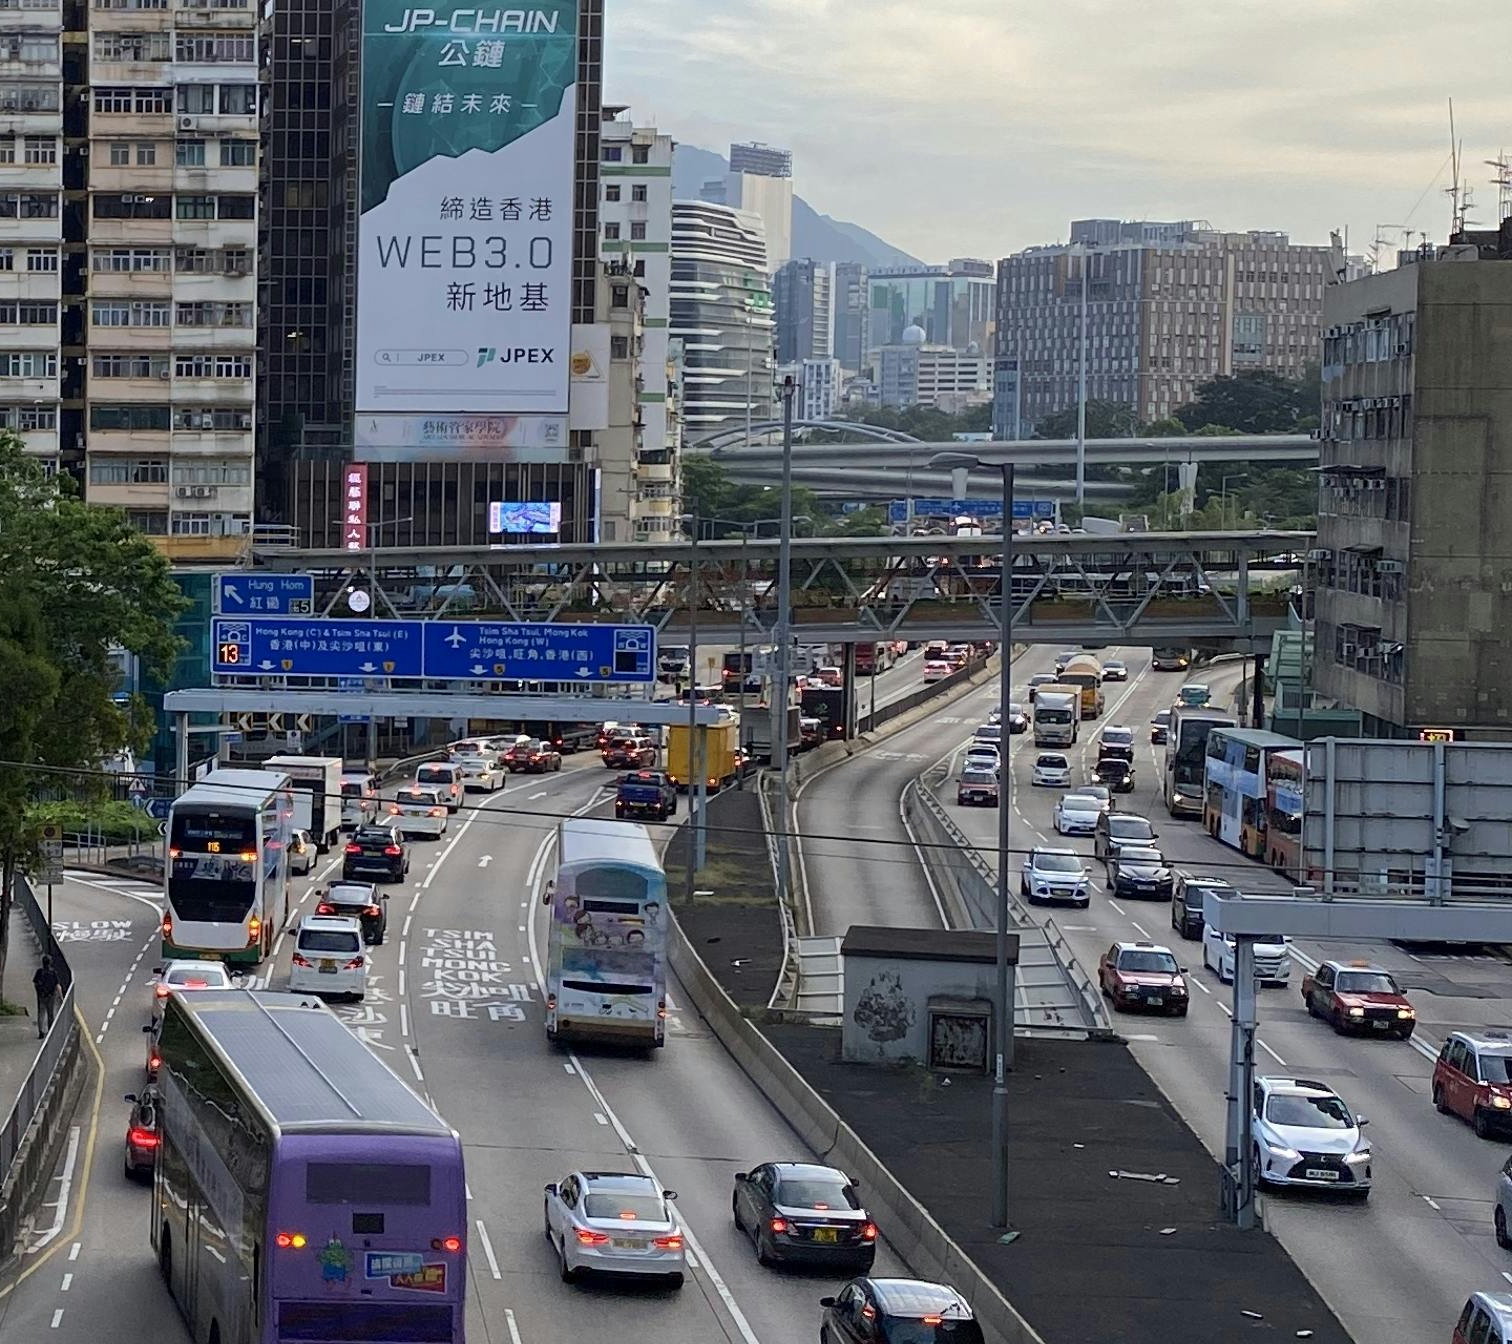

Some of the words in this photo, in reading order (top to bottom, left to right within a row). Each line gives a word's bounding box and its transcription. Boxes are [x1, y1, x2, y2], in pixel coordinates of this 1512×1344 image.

[384, 8, 560, 34] JP-CHAIN
[438, 39, 506, 68] 公鏈
[401, 92, 513, 115] 鏈結未來
[439, 196, 553, 222] 締造香港
[376, 235, 553, 269] WEB3.0
[446, 281, 549, 312] 新地基
[417, 352, 445, 362] JPEX
[500, 348, 555, 363] JPEX
[248, 579, 274, 592] Hung
[281, 580, 304, 590] Hom
[300, 600, 310, 613] 5
[255, 627, 279, 637] Hong
[281, 628, 304, 638] Kong
[305, 628, 322, 638] (C)
[323, 629, 330, 637] &
[332, 628, 352, 637] Tsim
[354, 629, 371, 637] Sha
[393, 630, 408, 640] (E)
[479, 627, 500, 636] Tsim
[501, 627, 519, 636] Sha
[544, 628, 569, 638] Mong
[570, 628, 588, 637] Kok
[479, 637, 503, 646] Hong
[505, 637, 529, 647] Kong
[531, 637, 549, 647] (W)
[221, 644, 238, 664] 13
[51, 920, 132, 930] SLOW
[422, 928, 494, 941] TSIM
[431, 938, 497, 951] SHA
[420, 946, 496, 961] TSUI
[421, 957, 512, 972] MONG
[434, 968, 505, 983] KOK
[430, 1000, 527, 1022] 旺角
